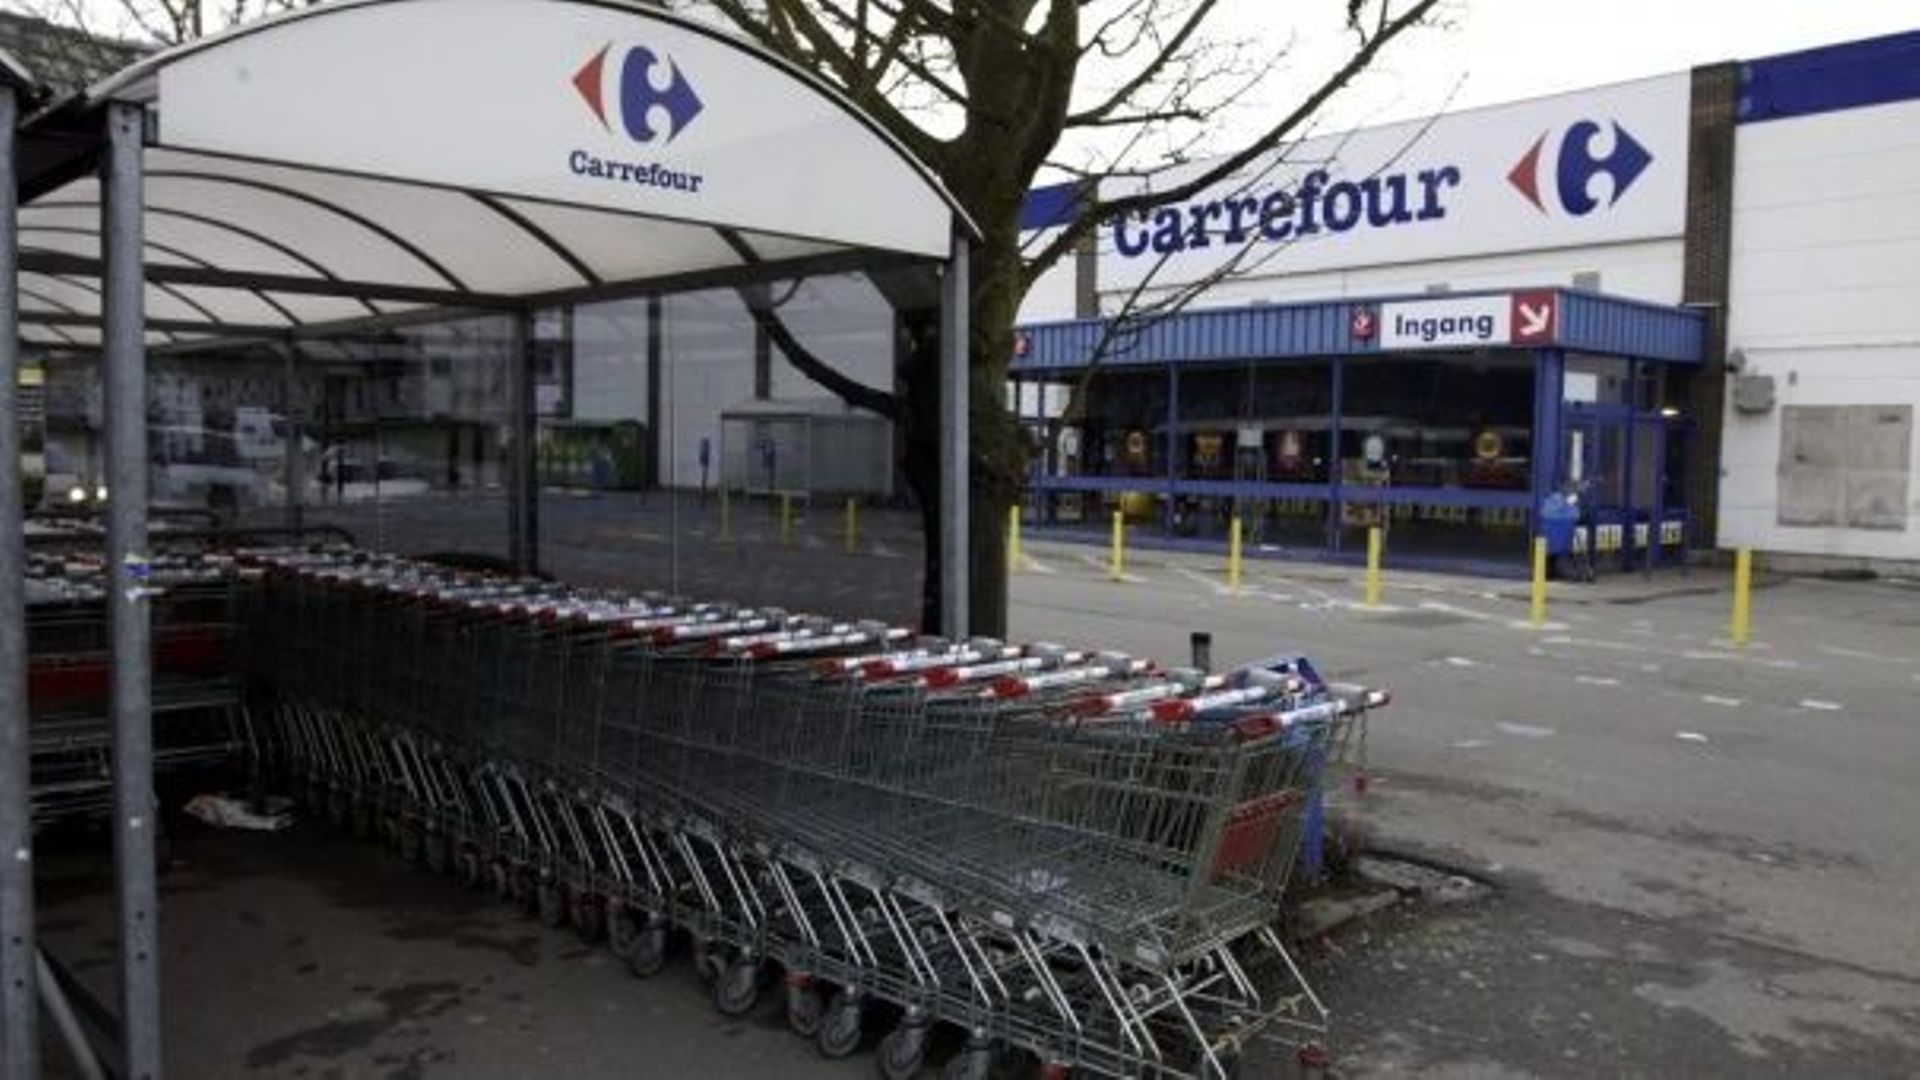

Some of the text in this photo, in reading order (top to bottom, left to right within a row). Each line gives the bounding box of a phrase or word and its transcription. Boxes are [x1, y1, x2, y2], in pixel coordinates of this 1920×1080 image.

[569, 149, 703, 193] Carrefour
[1113, 164, 1461, 258] Carrefour
[1395, 313, 1494, 342] Ingang
